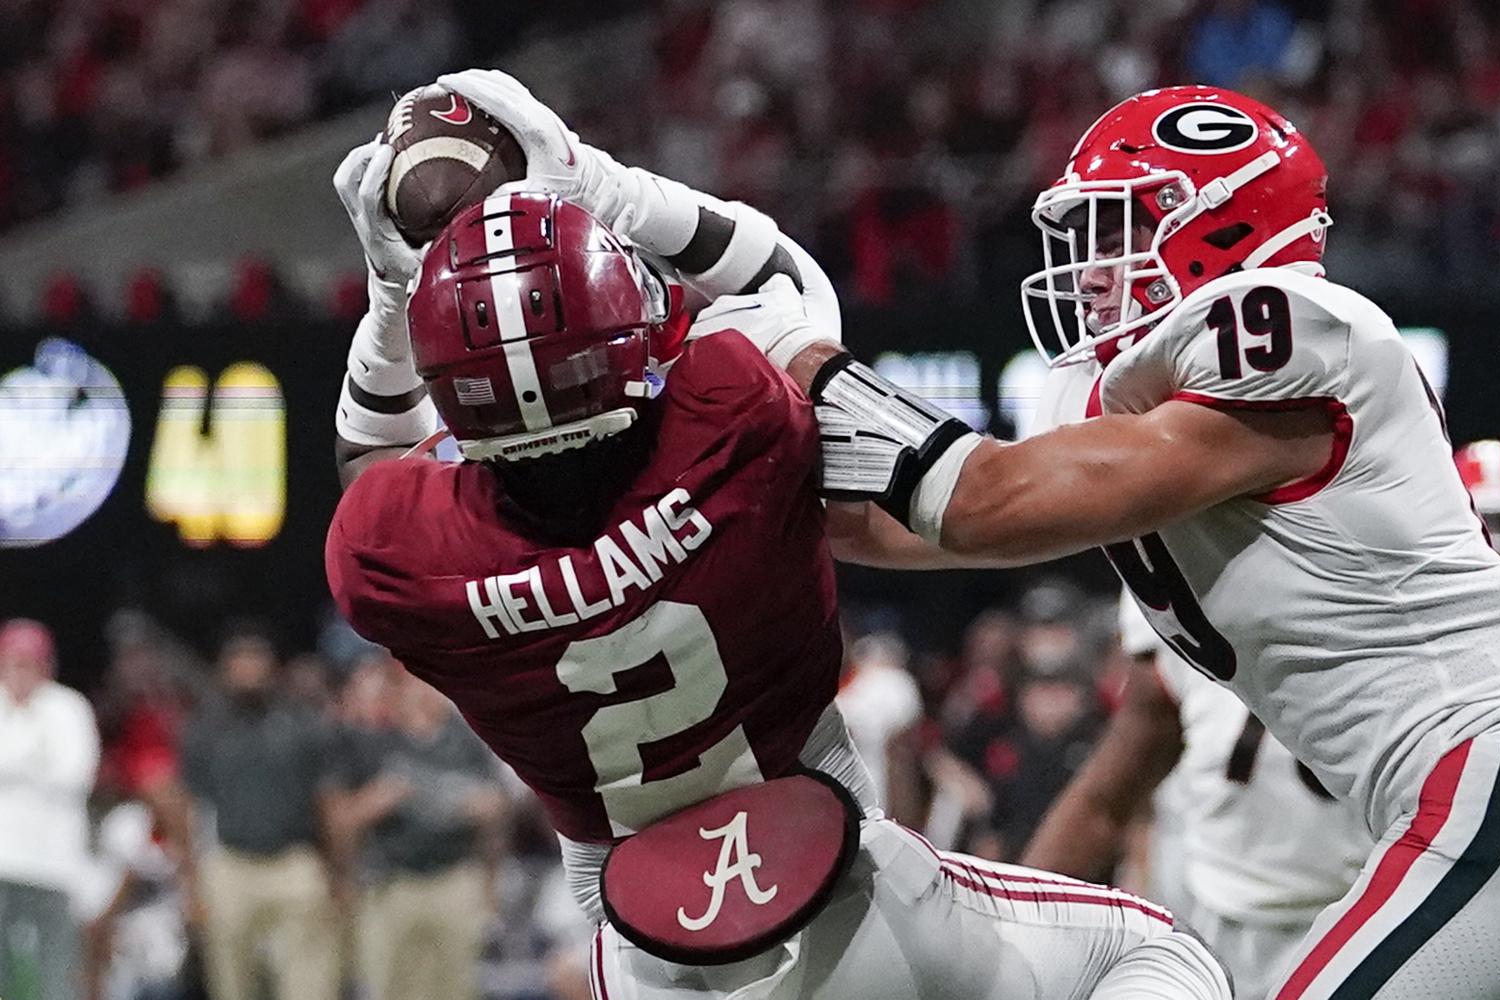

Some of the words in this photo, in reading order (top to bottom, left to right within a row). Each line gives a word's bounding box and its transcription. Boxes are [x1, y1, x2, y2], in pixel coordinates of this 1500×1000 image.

[1154, 103, 1256, 151] G
[1206, 285, 1293, 380] 19
[502, 435, 558, 455] CRIMSON
[561, 428, 591, 442] TIDE
[465, 487, 713, 639] HELLAMS
[555, 600, 765, 838] 2
[677, 811, 778, 931] A
